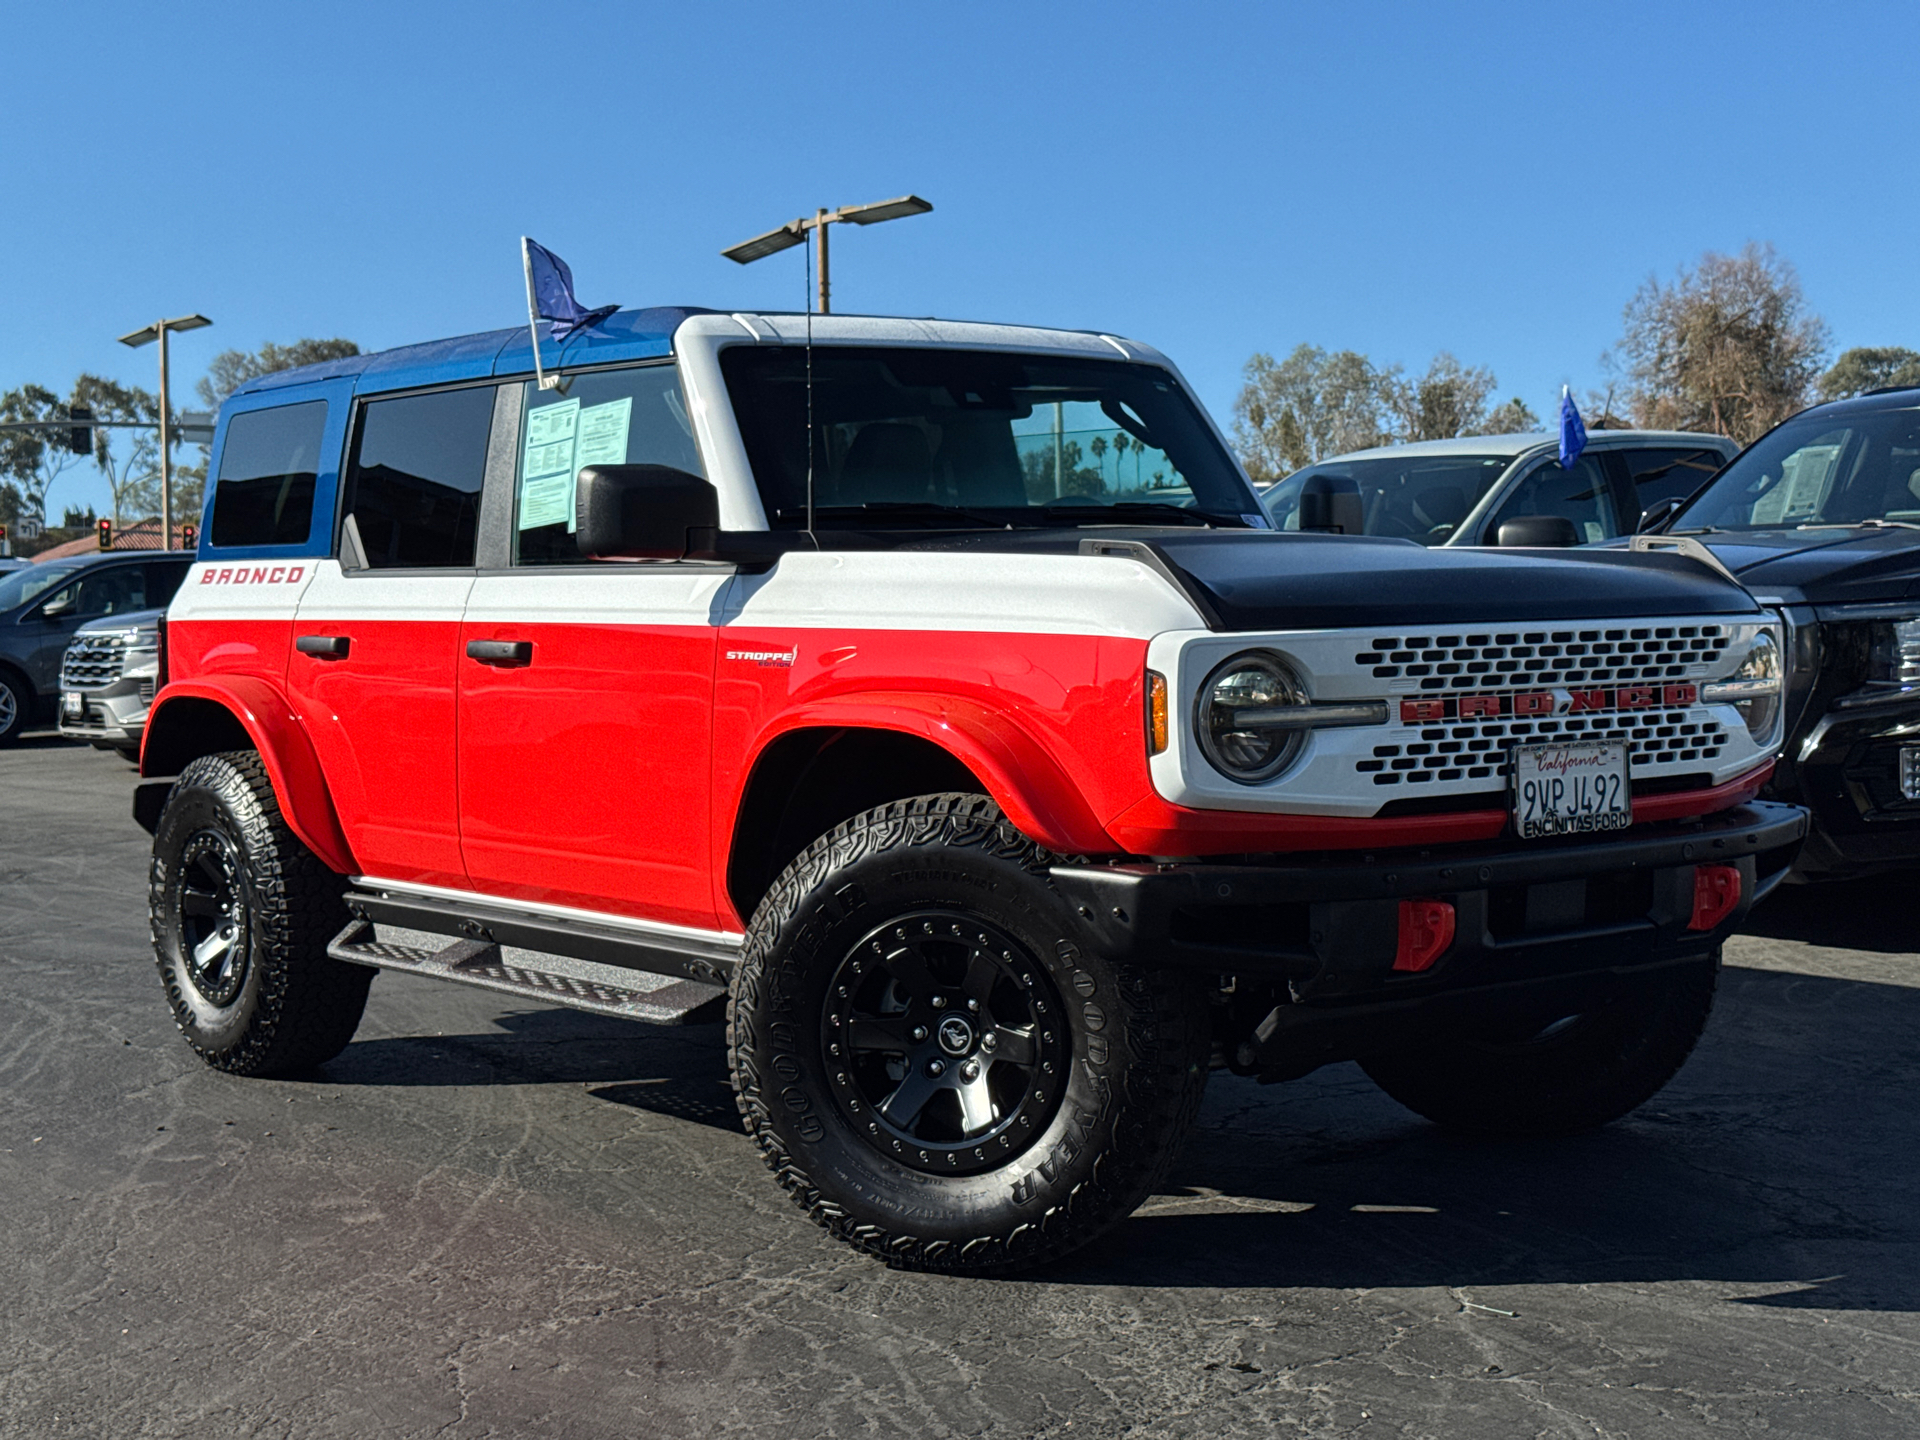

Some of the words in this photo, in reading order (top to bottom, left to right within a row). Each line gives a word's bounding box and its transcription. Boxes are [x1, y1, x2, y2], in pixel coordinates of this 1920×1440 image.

[200, 567, 305, 585] BRONCO
[726, 651, 792, 661] STROPPE
[1400, 684, 1697, 722] BRONCO
[1538, 751, 1606, 775] California
[1523, 773, 1622, 821] 9VPJ492
[1524, 814, 1593, 838] ENCINITAS
[1595, 813, 1628, 829] FORD
[768, 882, 868, 1143] GOODYEAR
[1010, 938, 1112, 1206] GOODYEAR
